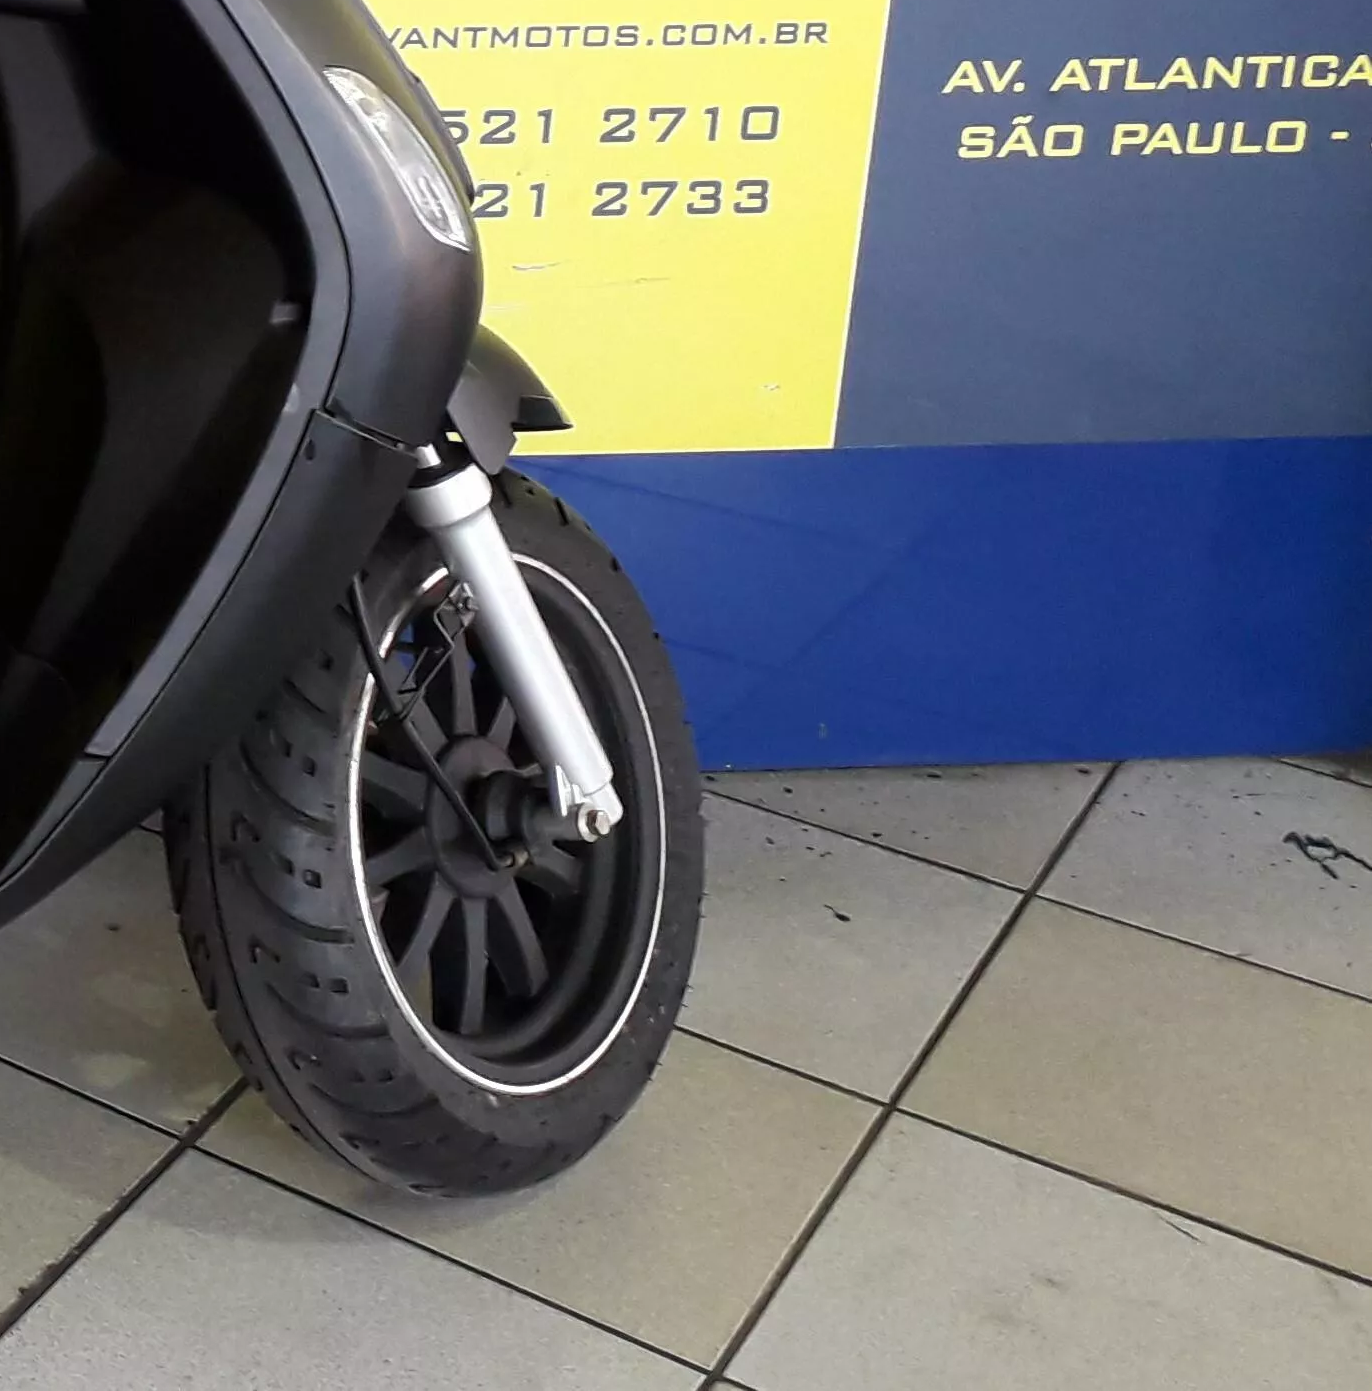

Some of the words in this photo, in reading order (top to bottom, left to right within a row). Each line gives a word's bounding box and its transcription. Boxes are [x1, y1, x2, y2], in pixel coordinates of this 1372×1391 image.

[940, 59, 1025, 94] AV.
[1050, 53, 1372, 93] ATLANTICA
[598, 104, 781, 144] 2710
[957, 115, 1086, 160] SÃO
[1110, 119, 1308, 156] PAULO
[590, 178, 770, 218] 2733
